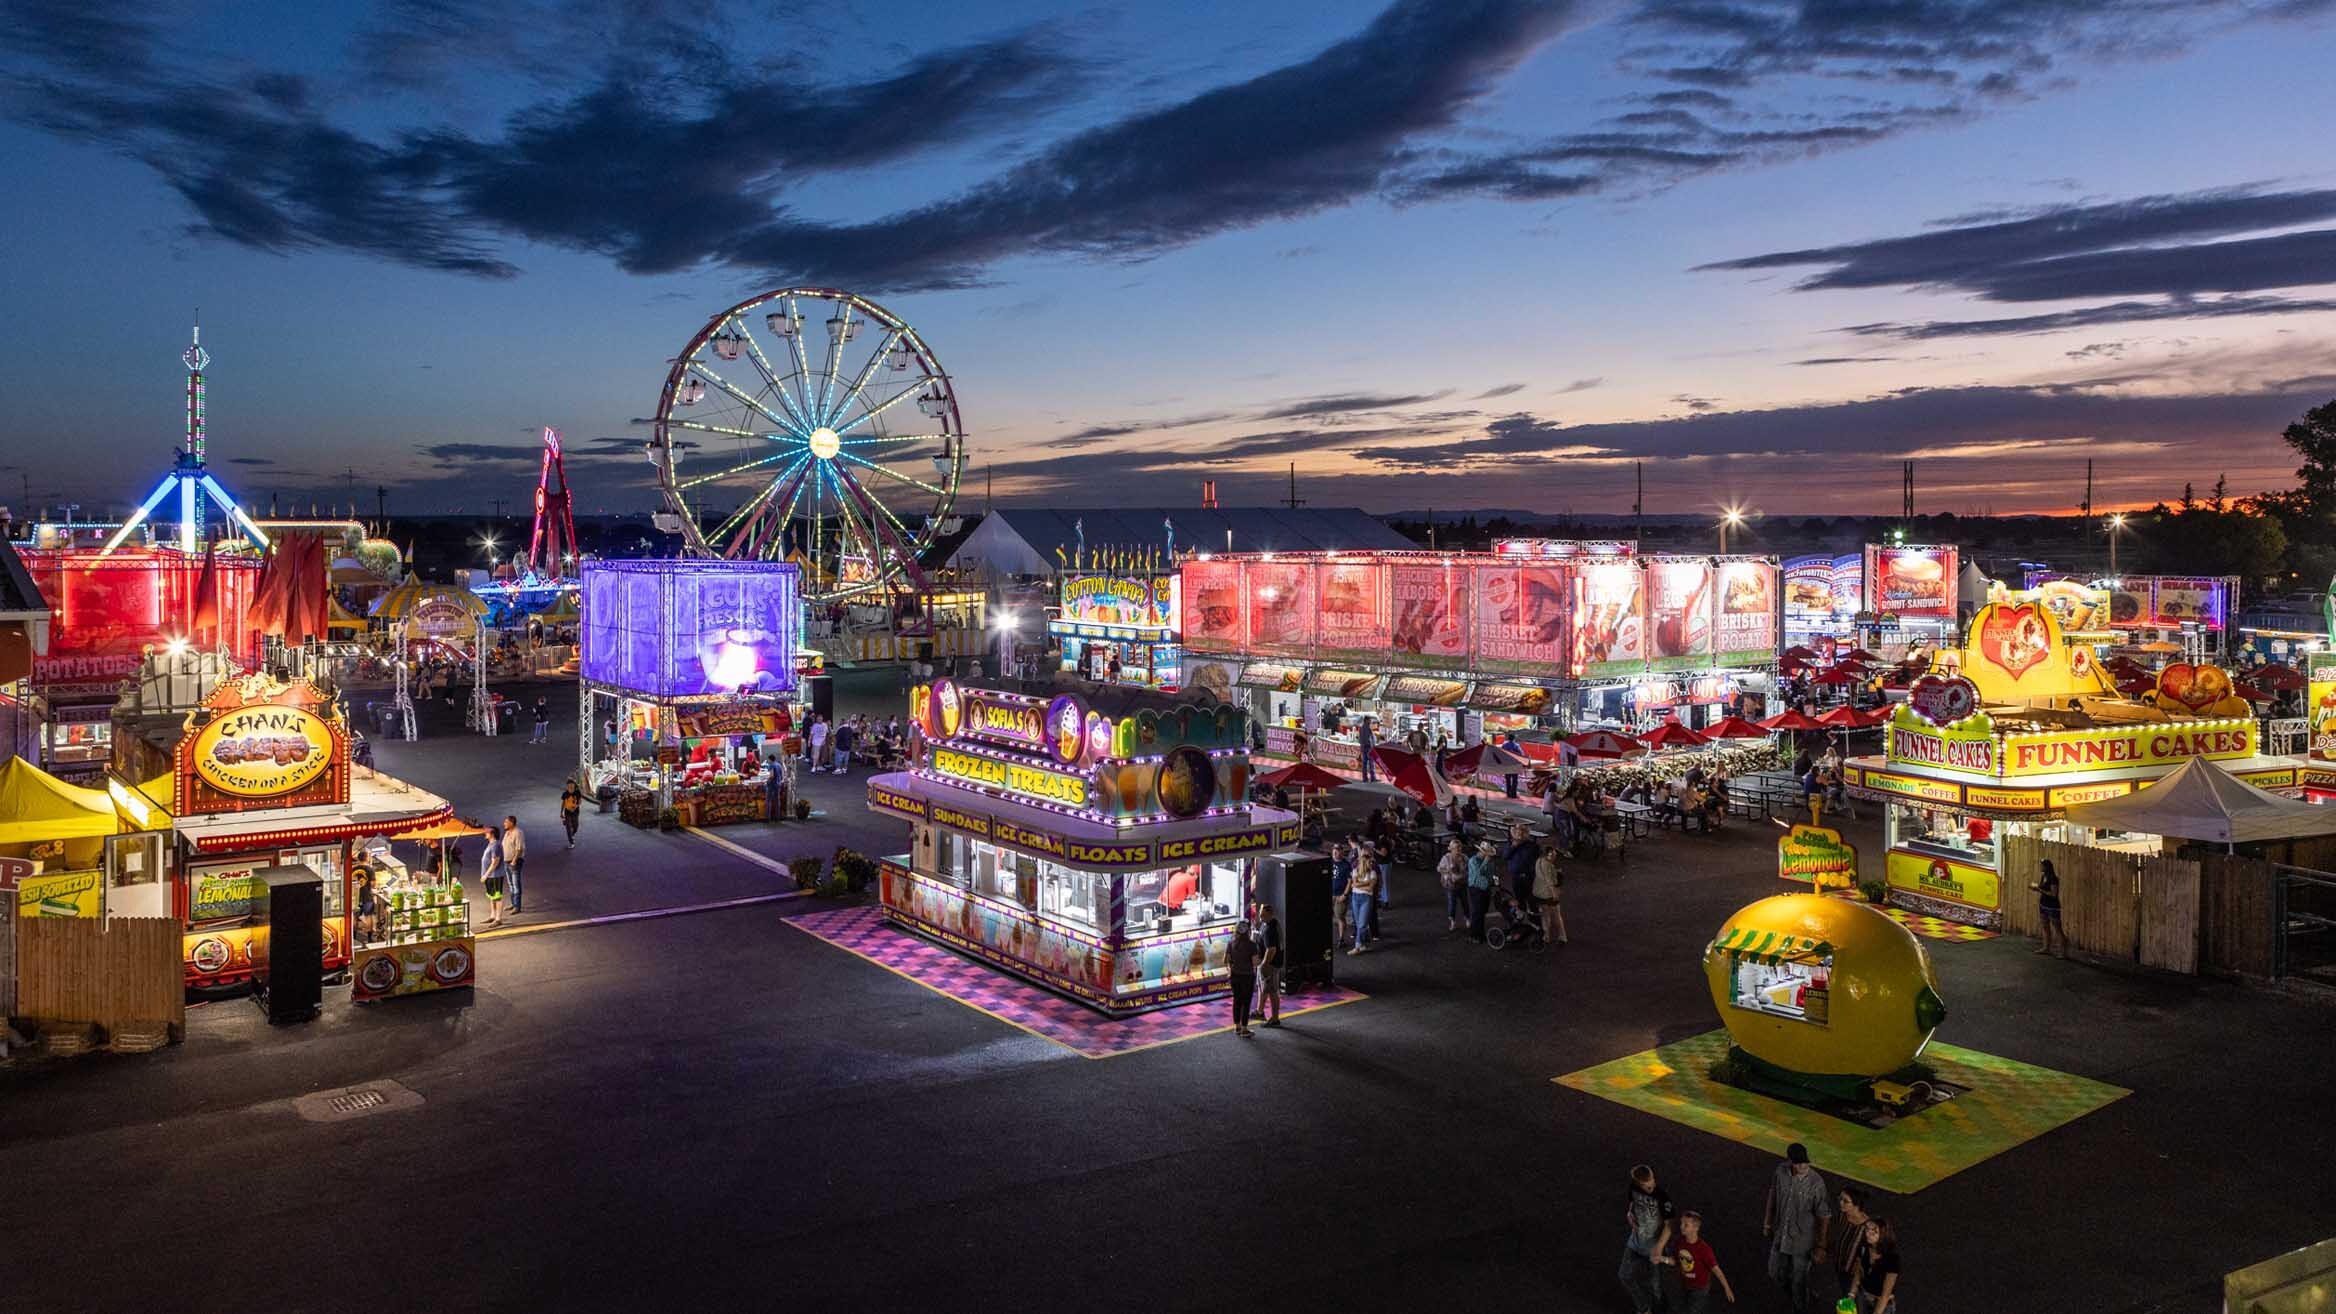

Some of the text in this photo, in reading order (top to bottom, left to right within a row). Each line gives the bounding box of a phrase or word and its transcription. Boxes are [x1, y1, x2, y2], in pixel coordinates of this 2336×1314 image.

[1065, 577, 1106, 602] COTTON
[1108, 578, 1147, 605] CANDY
[1907, 598, 1947, 609] SANDWICH
[1319, 611, 1371, 628] BRISKE
[1319, 630, 1379, 648] POTATO
[1480, 623, 1536, 641] BRISKET
[1720, 631, 1770, 650] POTATO
[1480, 640, 1554, 660] SANDWICH
[35, 655, 141, 680] POTATOES
[1390, 679, 1444, 694] HOT DOGS
[221, 713, 306, 737] CHAN'S
[987, 706, 1024, 733] SOFIA'S
[1894, 728, 1992, 771] FUNNEL CAKES
[2016, 729, 2248, 769] FUNNEL CAKES
[202, 759, 257, 789] CHICKEN
[259, 780, 278, 789] ON
[291, 752, 326, 782] STICK
[935, 751, 1085, 804] FROZEN TREATS
[2304, 773, 2336, 785] PIZZA
[1868, 777, 1917, 793] LEMONADE
[2253, 775, 2291, 786] PICKLES
[877, 791, 925, 815] ICE CREAM
[1922, 787, 1957, 800] COFFEE
[1970, 794, 2009, 805] FUNNEL
[2011, 797, 2041, 806] CAKES
[2062, 789, 2121, 802] COFFEE
[934, 808, 988, 833] SUNDAES
[996, 825, 1065, 856] ICE CREAM
[1162, 832, 1268, 858] ICE CREAM
[1281, 829, 1298, 842] FLO
[1071, 846, 1148, 862] FLOATS
[1783, 852, 1850, 875] Lemonade
[41, 874, 94, 898] SQUEEZED
[198, 886, 253, 905] LEMONA
